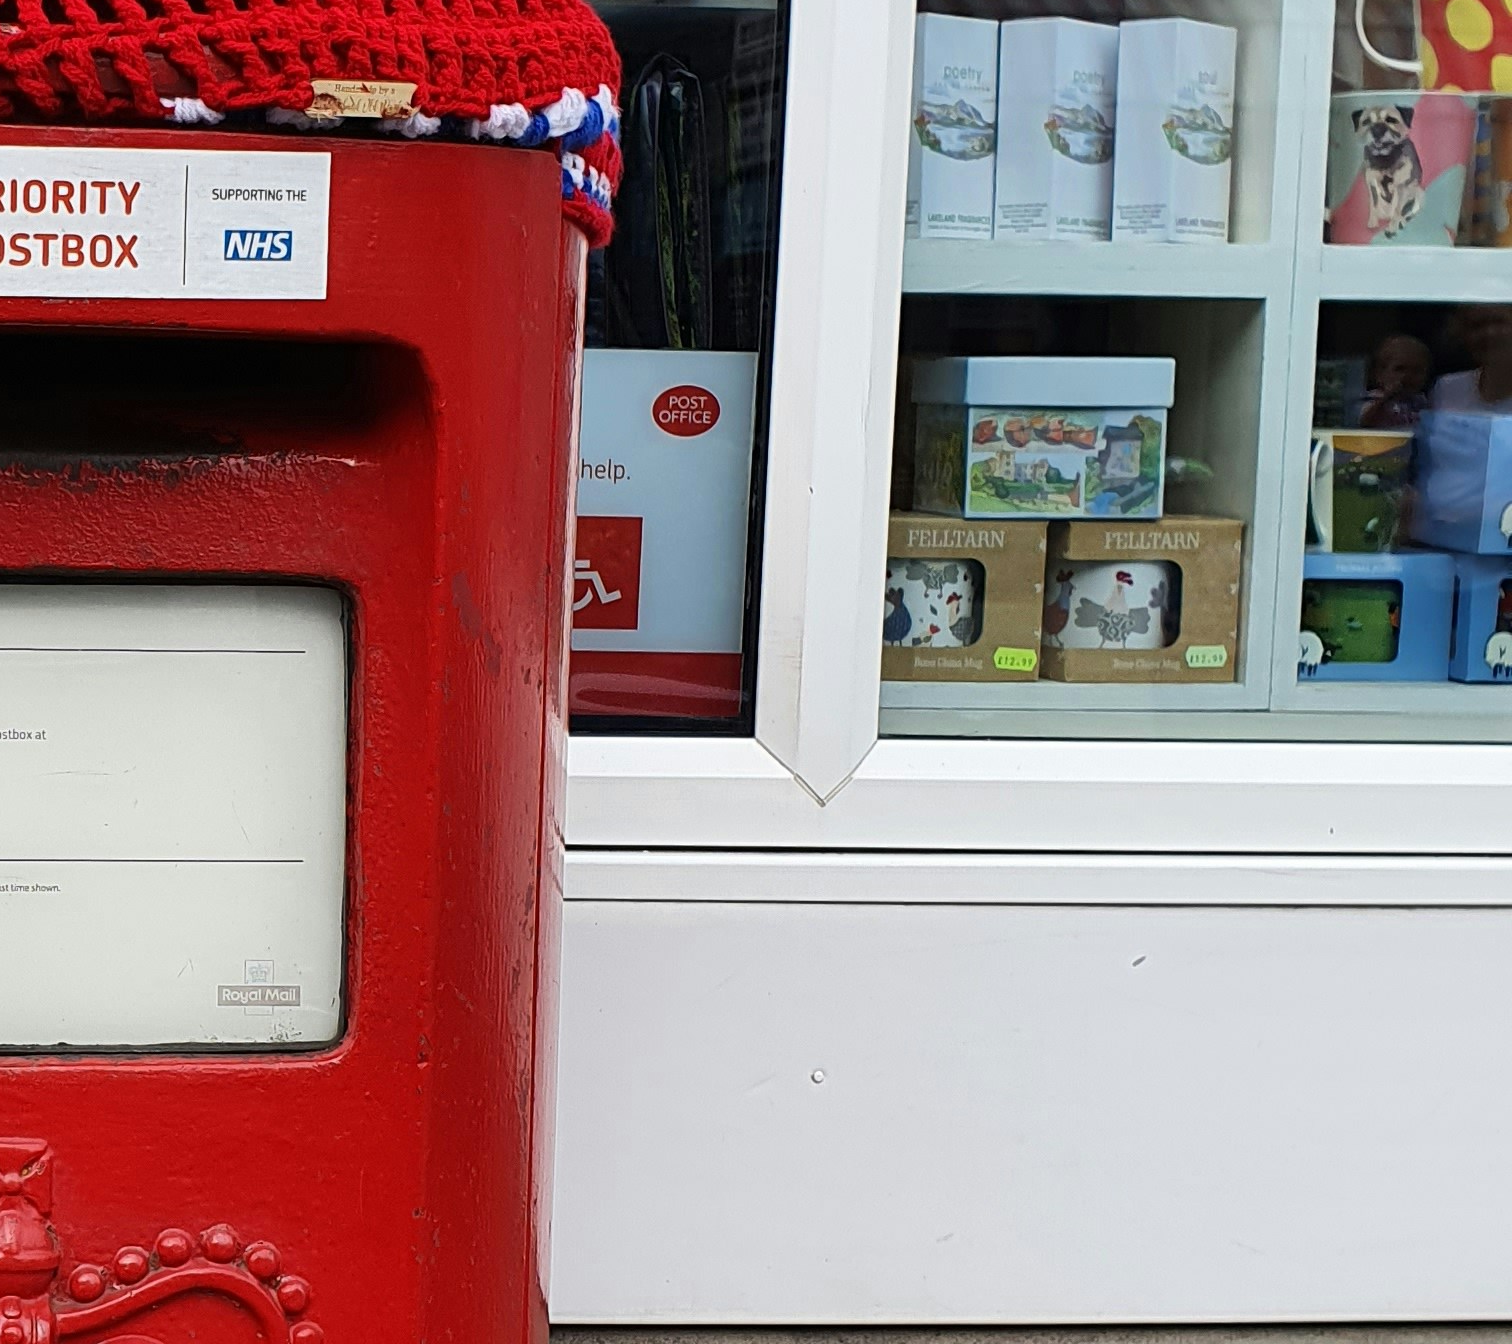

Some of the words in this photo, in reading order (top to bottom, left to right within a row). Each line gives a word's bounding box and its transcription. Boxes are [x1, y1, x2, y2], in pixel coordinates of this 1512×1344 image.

[211, 188, 284, 203] SUPPORTING
[286, 189, 308, 203] THE
[227, 232, 290, 260] NHS
[668, 395, 708, 410] POST
[659, 410, 712, 425] OFFICE
[581, 458, 631, 484] help.
[907, 529, 1006, 548] FELLTARN
[1105, 531, 1200, 550] FELLTARN
[998, 656, 1033, 666] £12.99
[35, 729, 46, 740] at
[11, 883, 30, 892] time
[31, 883, 61, 892] shown.
[222, 988, 262, 1004] Royal
[264, 988, 296, 1001] Mail
